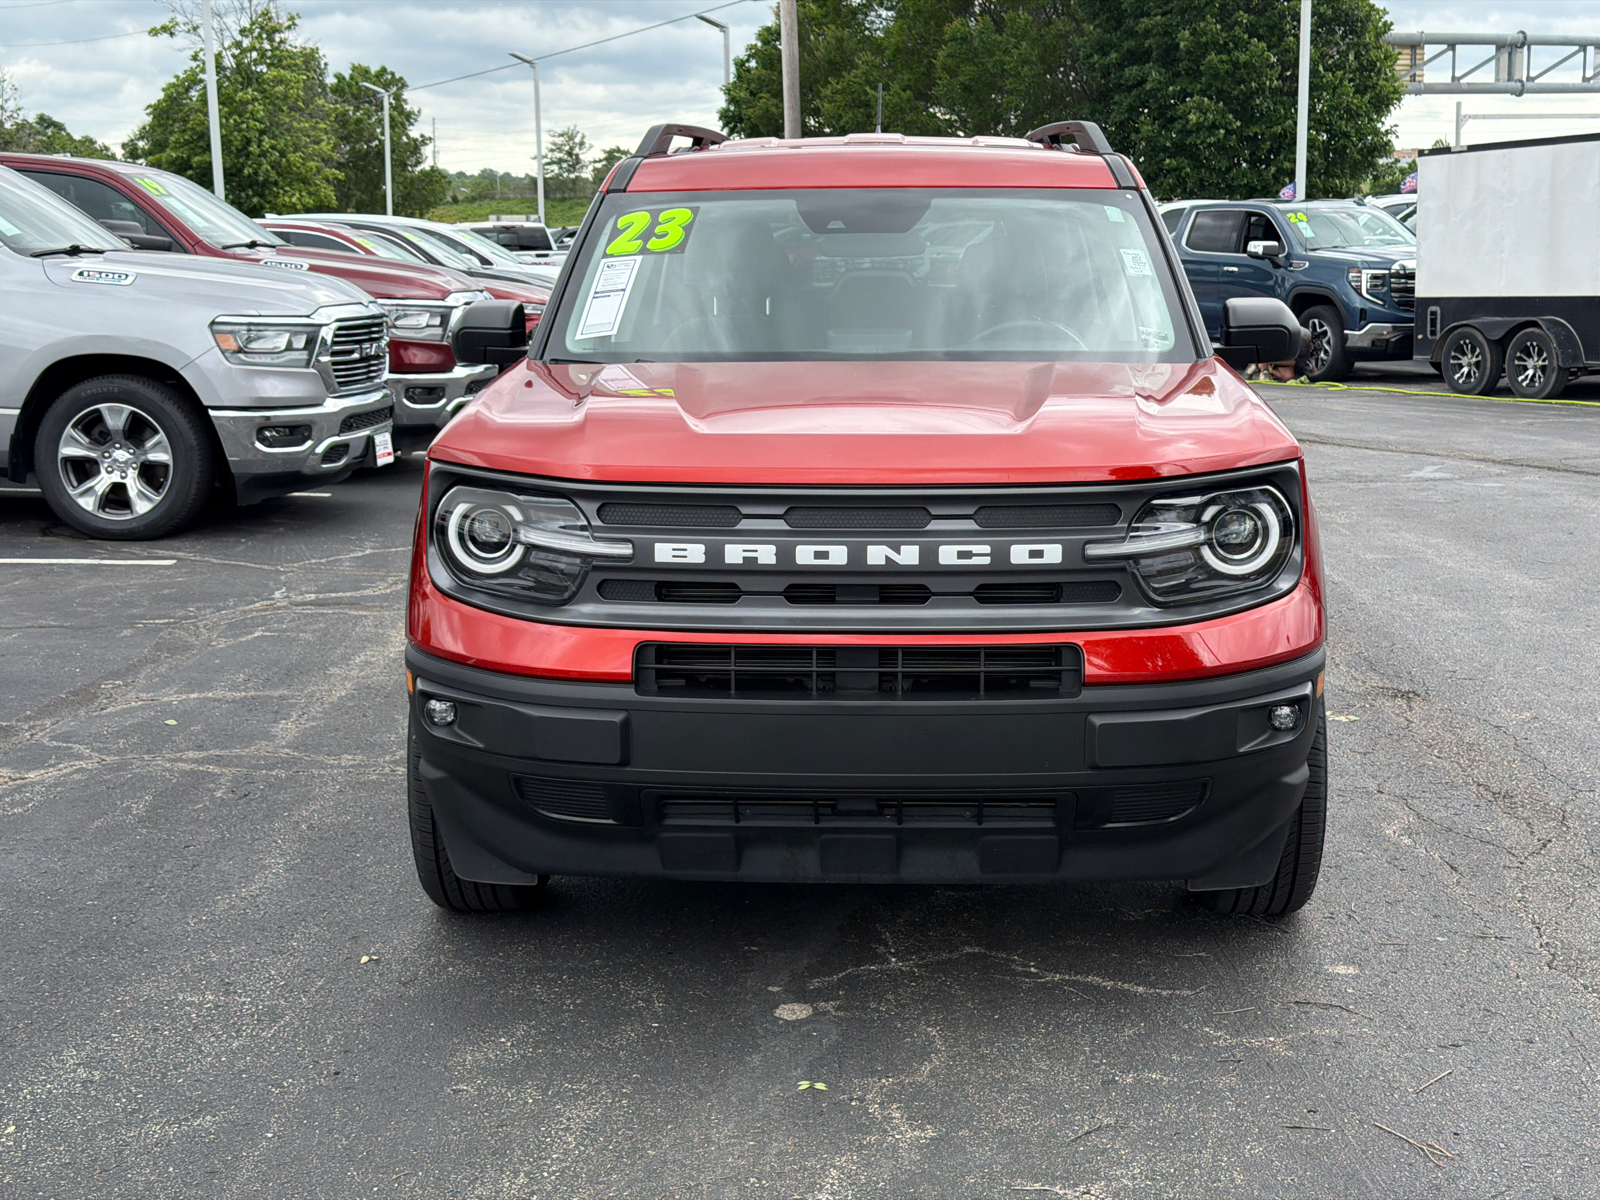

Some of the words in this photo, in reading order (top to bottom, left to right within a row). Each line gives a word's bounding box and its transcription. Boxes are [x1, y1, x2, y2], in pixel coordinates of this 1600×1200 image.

[134, 177, 169, 195] 19
[606, 208, 694, 256] 23
[82, 270, 128, 279] 1500
[653, 542, 1064, 565] BRONCO
